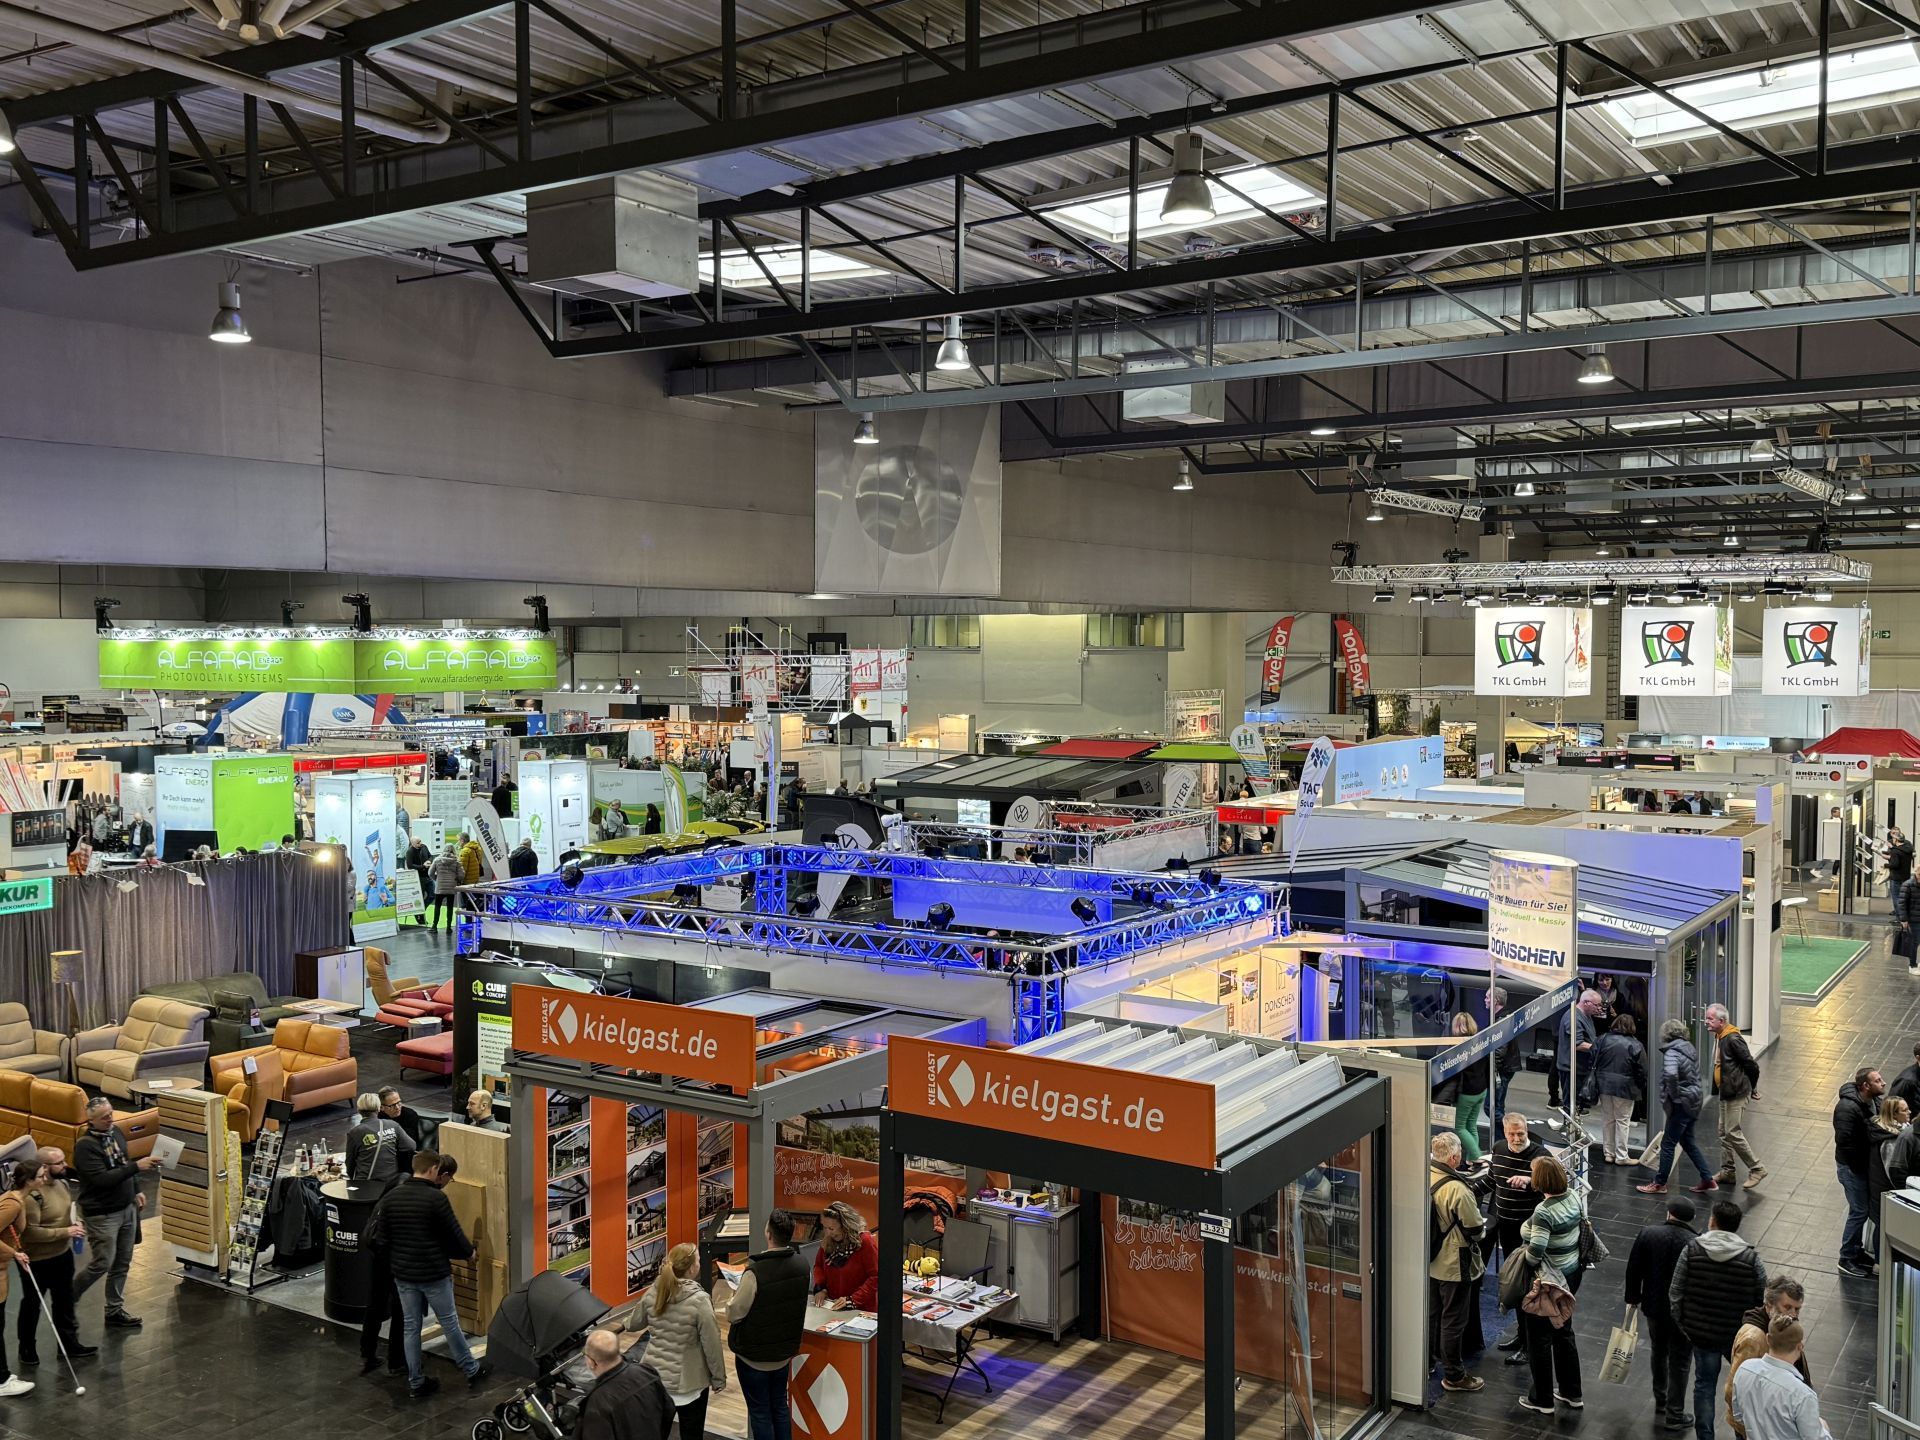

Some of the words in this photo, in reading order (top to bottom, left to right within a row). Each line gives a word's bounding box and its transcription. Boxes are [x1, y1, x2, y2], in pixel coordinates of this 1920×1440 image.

[158, 650, 271, 671] ALFARAD
[259, 656, 283, 664] ENERGY
[384, 650, 528, 671] ALFARAD
[514, 655, 541, 663] ENERGY
[160, 672, 233, 683] PHOTOVOLTAIK
[238, 673, 283, 683] SYSTEMS
[419, 674, 504, 685] www.alfaradenergy.de
[1492, 677, 1511, 686] TKL
[1513, 676, 1546, 686] GmbH
[1639, 677, 1658, 686] TKL
[1661, 676, 1696, 686] GmbH
[1781, 677, 1801, 686] TKL
[1803, 676, 1839, 686] GmbH
[185, 778, 209, 786] ENERGY
[258, 776, 288, 785] ENERGY
[1303, 781, 1320, 796] TAC
[1504, 895, 1528, 908] bauen
[1530, 899, 1545, 910] für
[1547, 902, 1568, 912] Sie!
[1538, 917, 1566, 926] Massiv
[1491, 937, 1566, 968] DONSCHEN
[486, 983, 507, 993] CUBE
[486, 991, 507, 999] CONCEPT
[1264, 993, 1296, 1015] DONSCHEN
[1552, 985, 1574, 1008] DONSCHEN
[541, 997, 549, 1044] KIELGAST
[583, 1013, 718, 1059] kielgast.de
[928, 1051, 937, 1106] KIELGAST
[982, 1072, 1165, 1132] kielgast.de
[790, 1154, 817, 1174] wird
[335, 1230, 359, 1240] CUBE
[1115, 1216, 1136, 1245] Es
[1140, 1218, 1178, 1245] wird
[1204, 1223, 1225, 1234] 3.323
